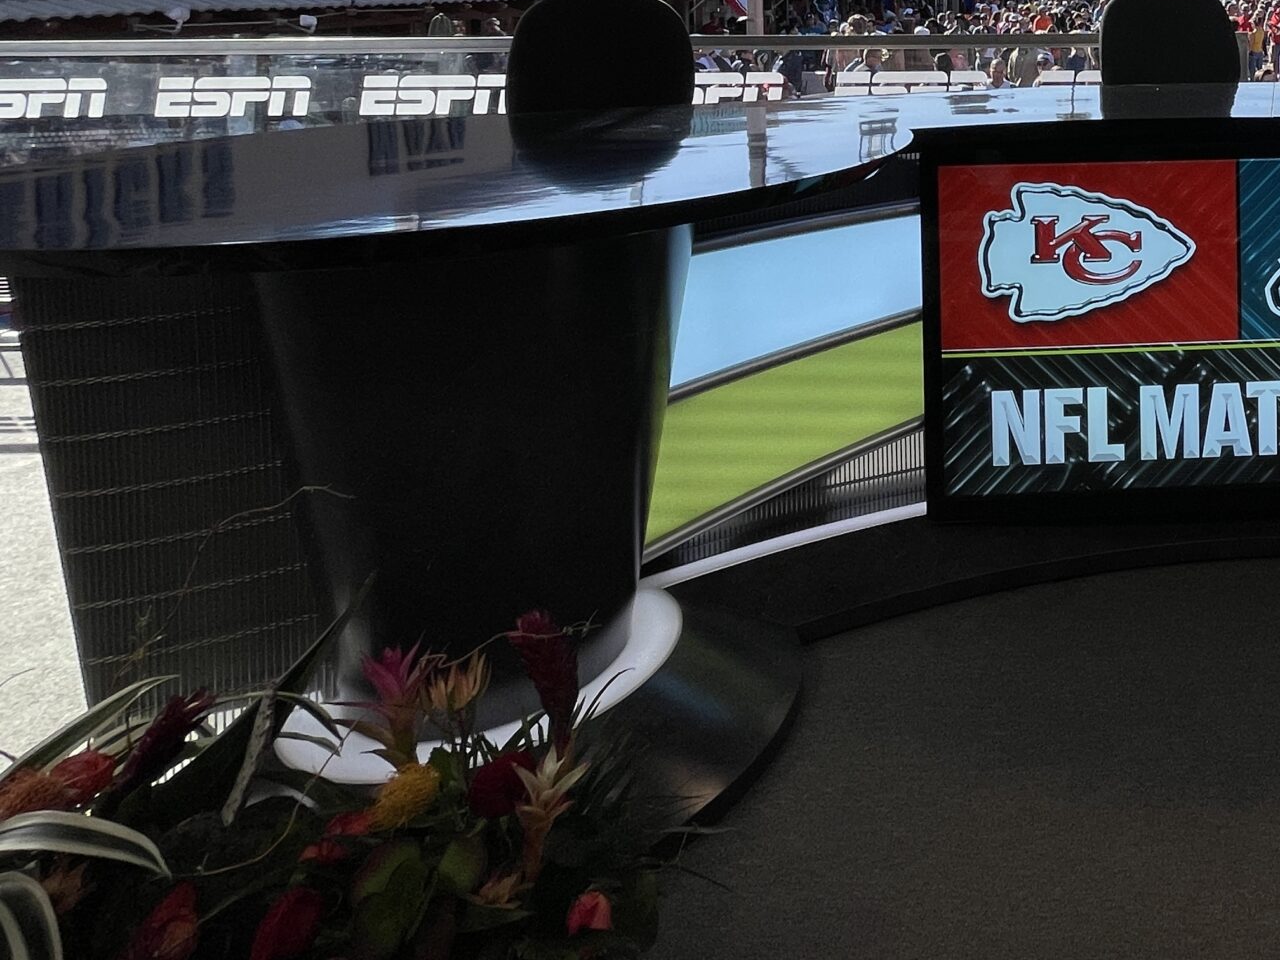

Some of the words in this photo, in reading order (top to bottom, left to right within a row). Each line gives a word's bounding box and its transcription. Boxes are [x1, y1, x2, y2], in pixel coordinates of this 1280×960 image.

[154, 76, 312, 118] ESPN
[359, 74, 507, 116] ESPN
[1029, 214, 1142, 285] KC
[990, 386, 1126, 467] NFL
